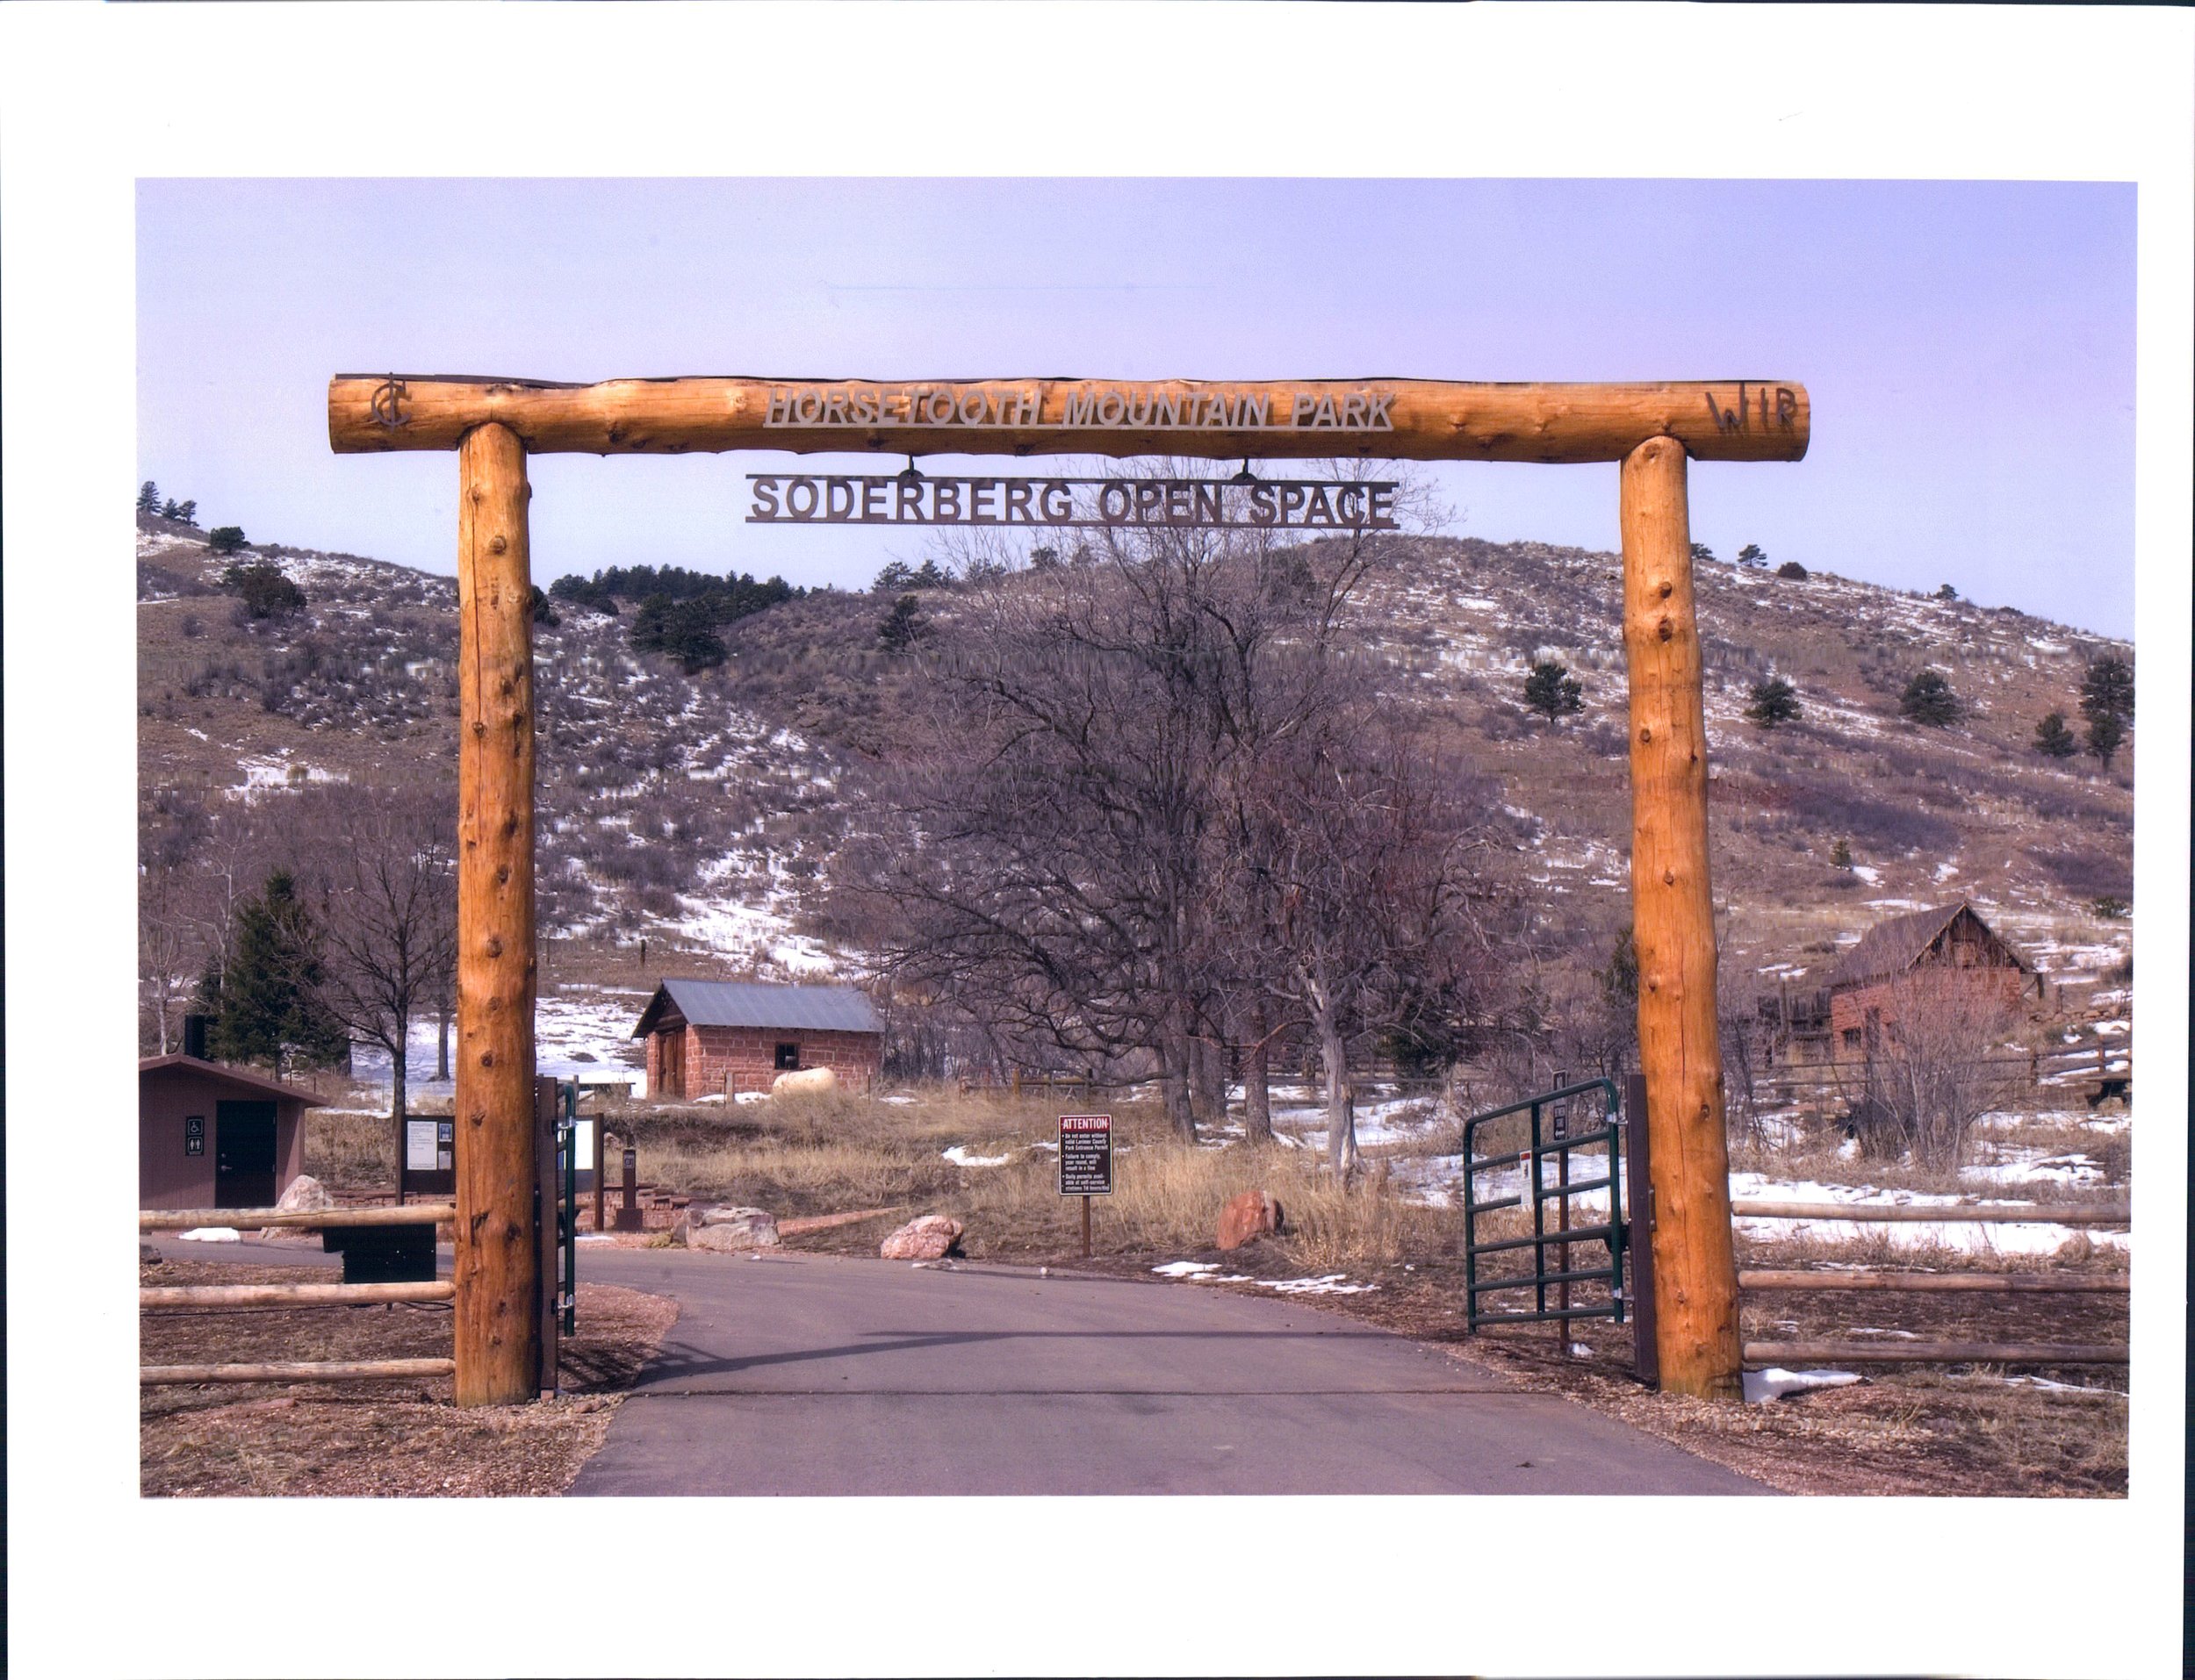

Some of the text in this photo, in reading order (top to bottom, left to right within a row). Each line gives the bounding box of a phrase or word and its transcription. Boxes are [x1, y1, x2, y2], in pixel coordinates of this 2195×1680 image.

[764, 387, 1396, 431] HORSETOOTH MOUNTAIN PARK
[752, 477, 1393, 528] SODERBERG OPEN SPACE
[1063, 1117, 1108, 1130] ATTENTION
